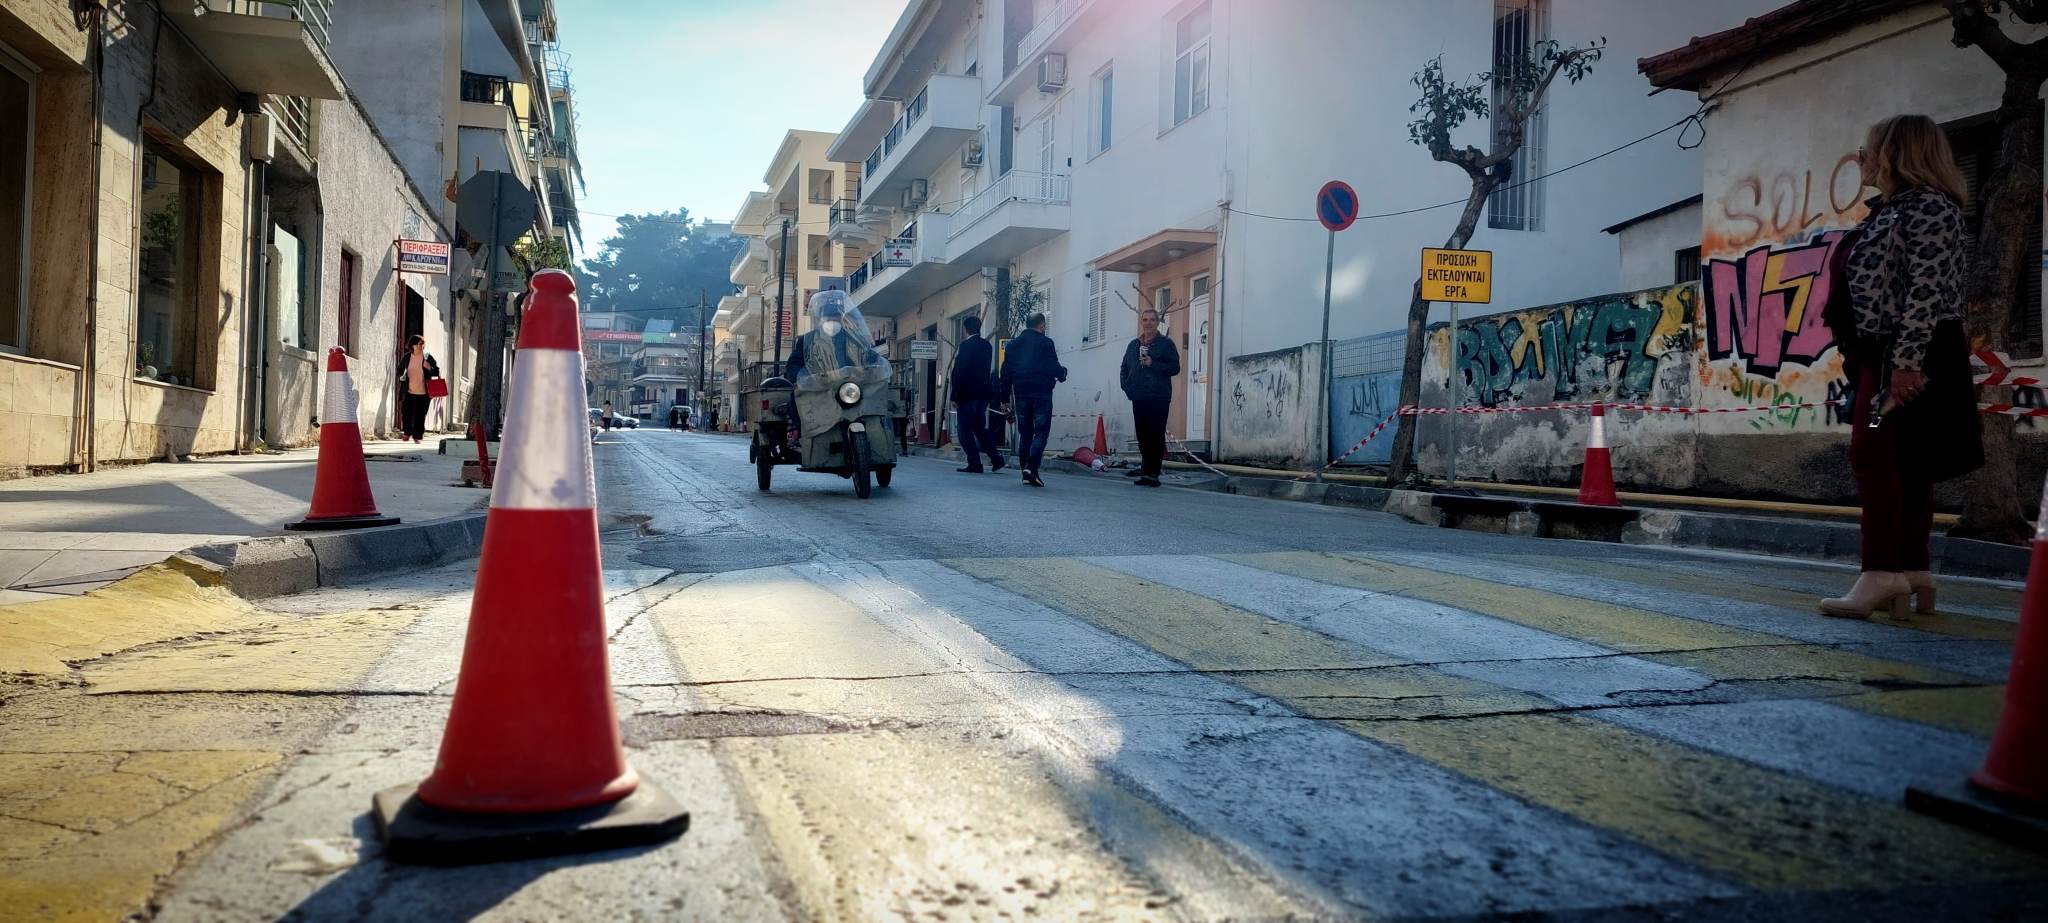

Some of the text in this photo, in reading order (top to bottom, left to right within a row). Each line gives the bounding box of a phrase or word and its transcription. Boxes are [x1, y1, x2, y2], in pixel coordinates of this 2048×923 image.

[1723, 153, 1863, 247] SOLO
[403, 242, 447, 255] ΠΕΡΙΦΡΑΞΕΙΣ
[1436, 253, 1477, 267] ΠΡΟΣΟΧΗ
[1427, 268, 1485, 283] ΕΚΤΕΛΟΥΝΤΑΙ
[1445, 285, 1467, 298] ΕΡΓΑ
